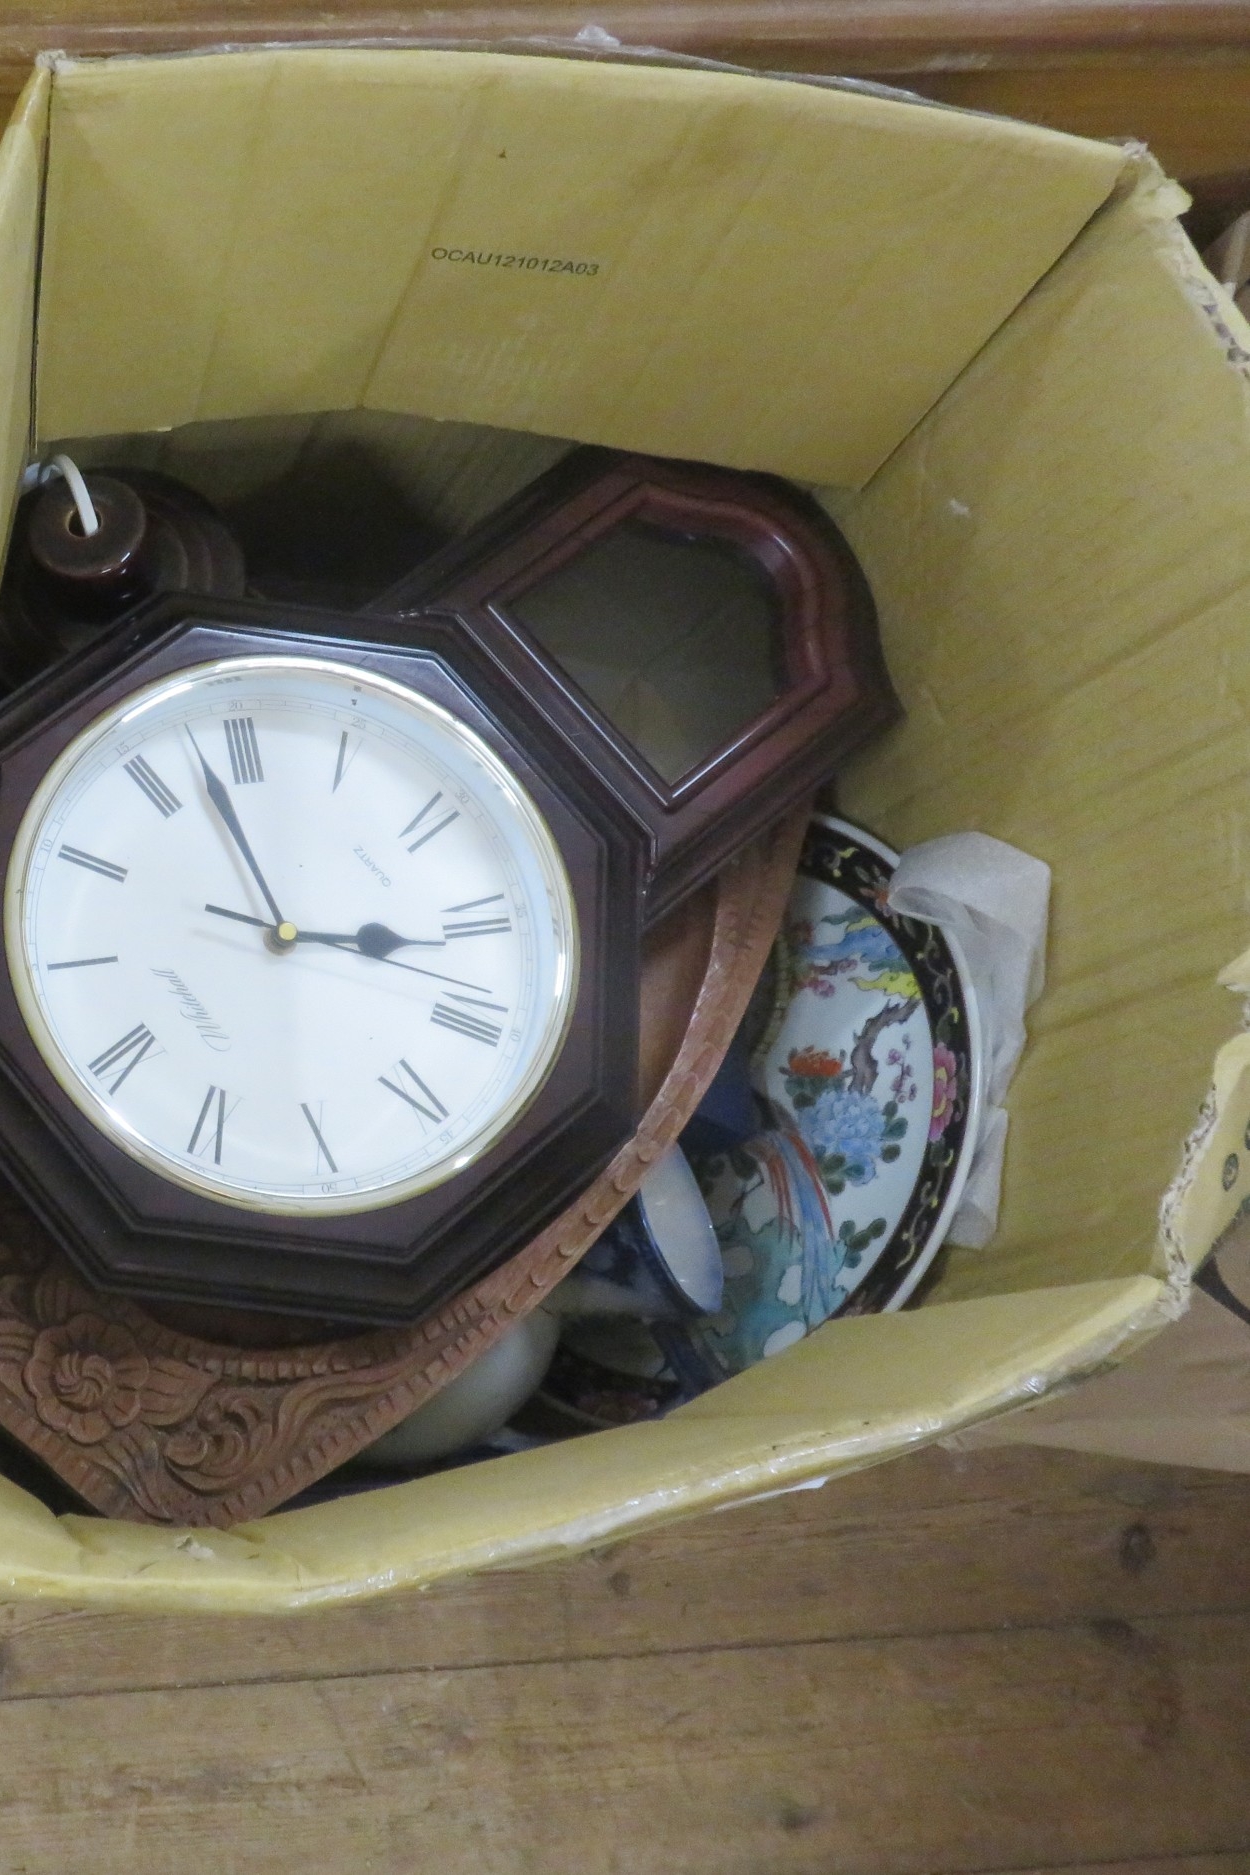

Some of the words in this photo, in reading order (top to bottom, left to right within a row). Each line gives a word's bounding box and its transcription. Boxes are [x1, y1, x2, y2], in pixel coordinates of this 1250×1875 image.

[431, 248, 599, 276] OCAU121012A03
[228, 700, 244, 712] 20
[350, 716, 367, 730] 25
[115, 741, 131, 756] 15
[223, 717, 265, 785] IIII
[332, 731, 365, 794] V
[123, 754, 183, 819] III
[398, 791, 460, 854] VI
[58, 844, 128, 883] II
[353, 844, 392, 888] QUARTZ
[440, 893, 512, 939] VII
[150, 967, 232, 1052] Whitehall
[430, 991, 508, 1047] VIII
[87, 1021, 168, 1097] XII
[187, 1084, 245, 1166] XI
[377, 1057, 450, 1135] IX
[299, 1100, 338, 1176] X
